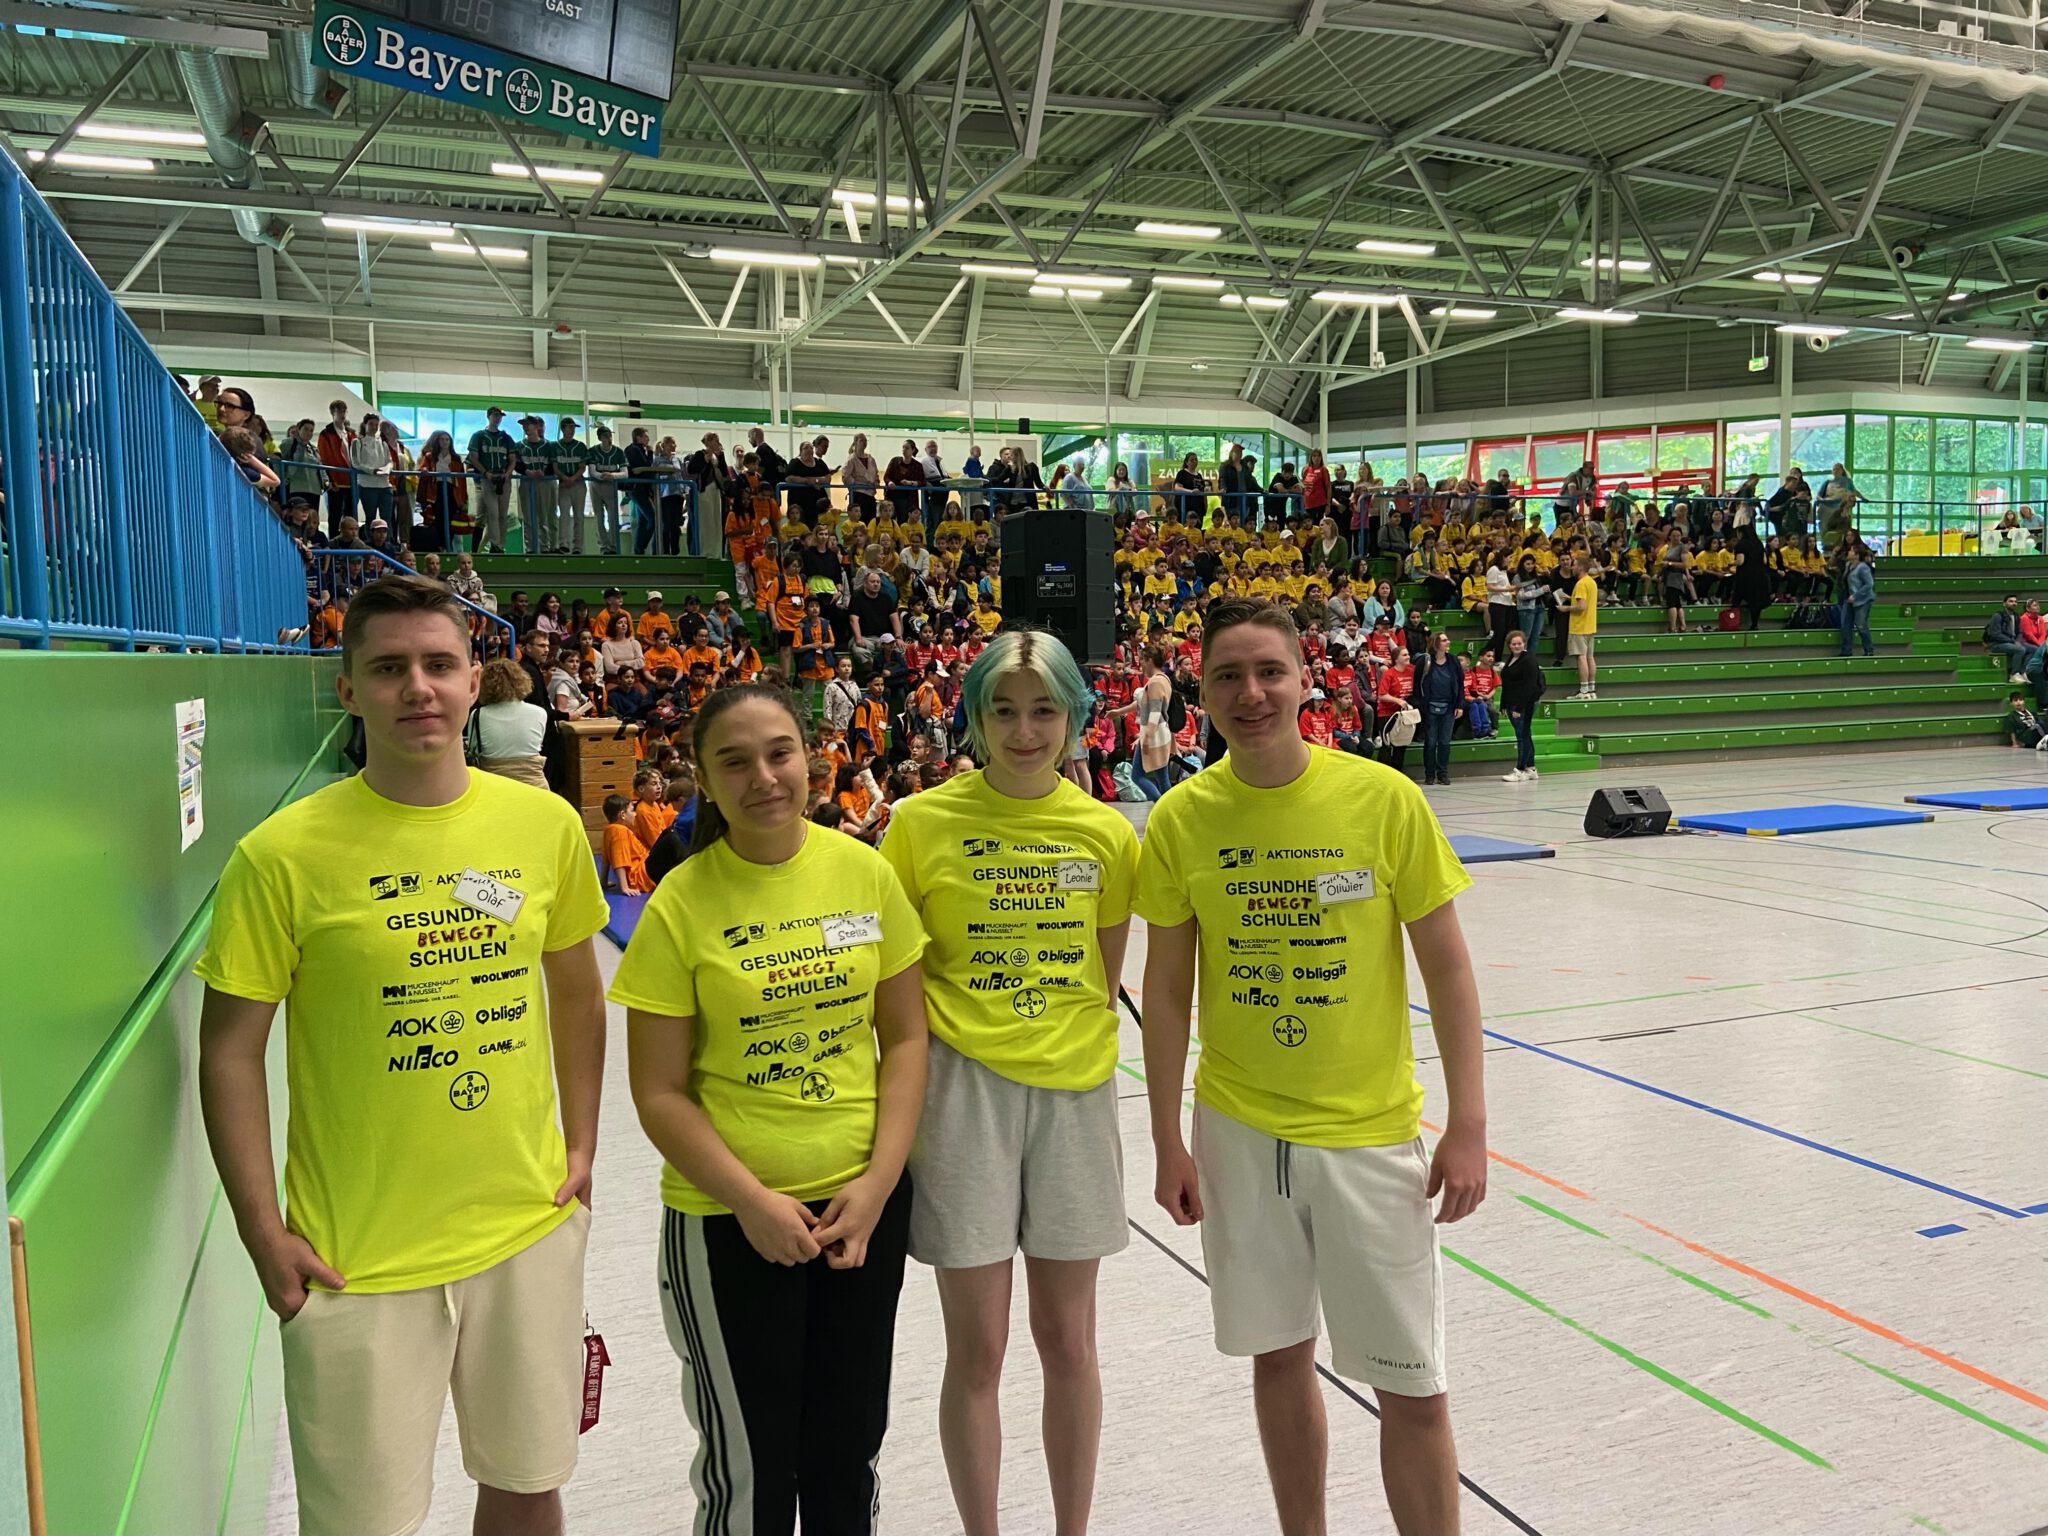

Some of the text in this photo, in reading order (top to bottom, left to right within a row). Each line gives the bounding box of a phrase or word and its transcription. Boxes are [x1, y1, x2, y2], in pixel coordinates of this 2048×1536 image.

[545, 0, 583, 20] GAST
[327, 27, 656, 141] BAYER Bayer BAYER Bayer
[986, 840, 1001, 849] SV
[1239, 848, 1344, 860] SV AKTIONSTAG
[400, 868, 522, 887] SV AKTSTAG
[973, 866, 1058, 881] GESUNDHE
[1065, 873, 1093, 884] Leonie
[995, 882, 1058, 896] BEWEGT
[1225, 879, 1316, 896] GESUNDHE
[1326, 882, 1364, 897] Oliwier
[476, 888, 507, 908] Olaf
[989, 896, 1065, 911] SCHULEN
[1247, 896, 1313, 912] BEWEGT
[386, 907, 496, 930] GESUNDH
[1036, 920, 1085, 931] WOOLWORTH
[1241, 912, 1320, 927] SCHULEN
[417, 925, 497, 947] BEWEGT
[748, 924, 765, 935] SV
[838, 927, 868, 941] Stella
[1289, 936, 1347, 947] WOOLWORTH
[409, 940, 508, 968] SCHULEN
[969, 948, 1085, 965] AOK bliggit
[407, 978, 460, 990] MUCKENHAUPT
[470, 967, 529, 985] WOOLWORTH
[767, 960, 836, 984] BEWEGT
[1228, 963, 1347, 981] AOK bliggit
[761, 973, 848, 1001] SCHULEN
[815, 992, 868, 1011] WOOLWORTH
[1016, 999, 1044, 1008] BAYER
[387, 1000, 528, 1038] AOK bliggit
[1276, 1027, 1304, 1035] BAYER
[744, 1038, 788, 1057] AOK
[453, 1083, 487, 1098] BAYER
